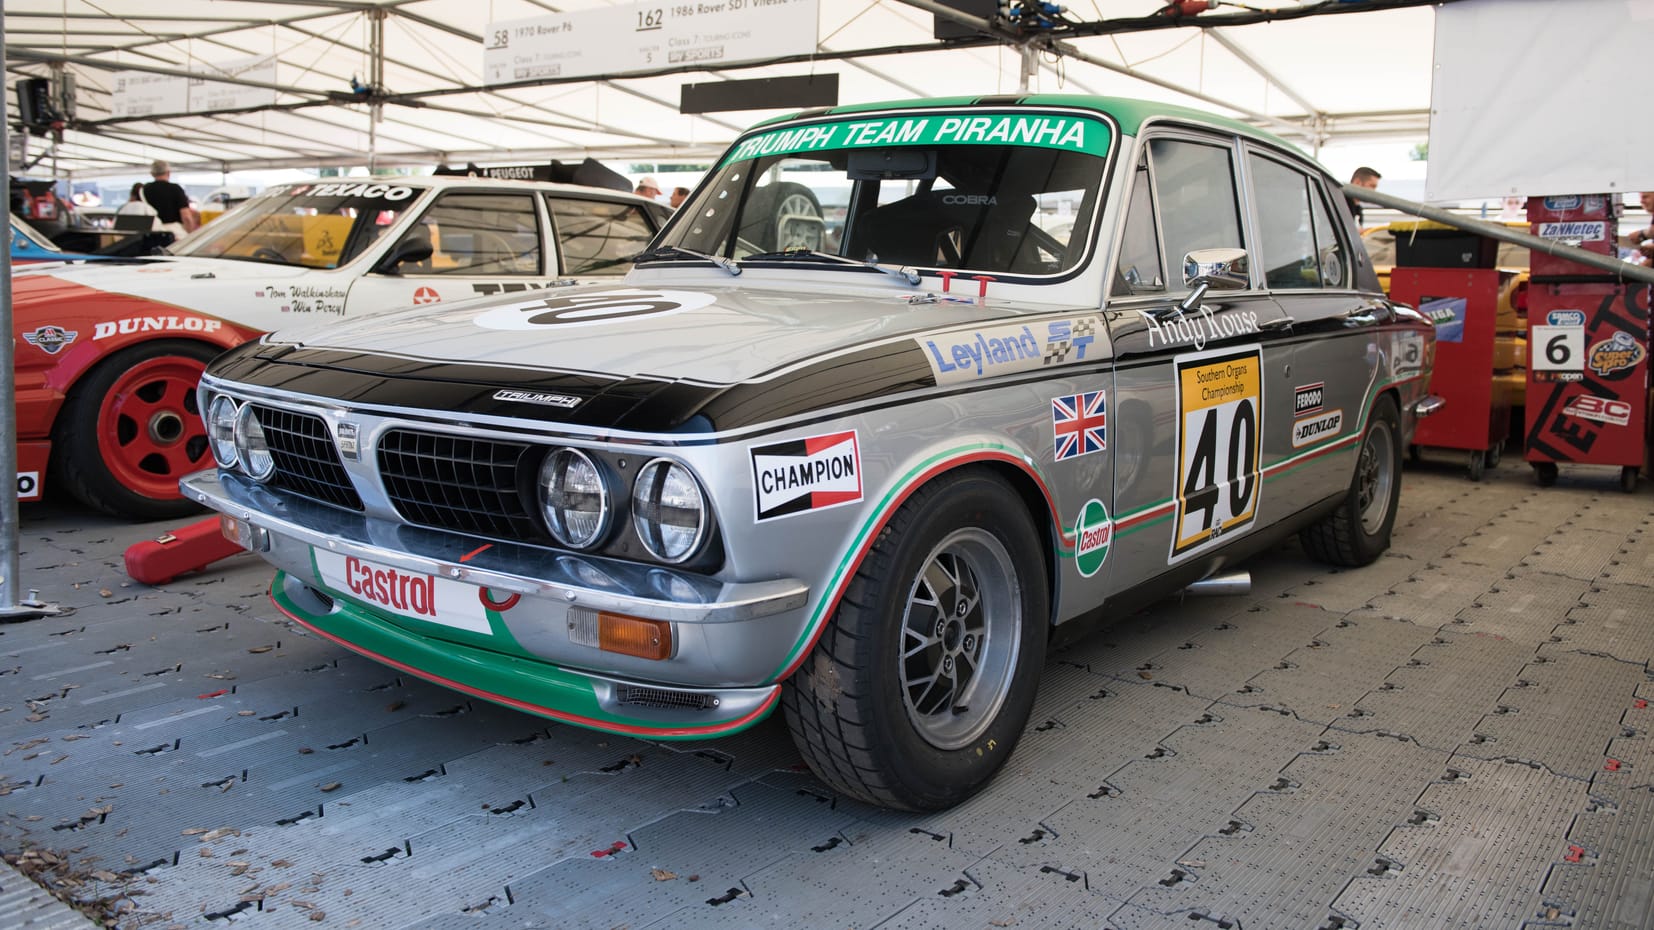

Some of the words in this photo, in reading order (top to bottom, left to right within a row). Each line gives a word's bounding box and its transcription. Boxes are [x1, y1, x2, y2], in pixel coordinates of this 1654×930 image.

[638, 9, 663, 26] 162
[671, 7, 694, 17] 1986
[698, 3, 725, 14] Rover
[494, 30, 508, 46] 58
[537, 25, 560, 35] Rover
[730, 125, 838, 161] TRIUMPH
[842, 119, 930, 146] TEAM
[933, 118, 1085, 148] PIRANHA
[490, 167, 534, 179] PEUGEOT
[306, 184, 413, 201] TEXACO
[942, 195, 998, 206] COBRA
[266, 286, 286, 298] Tom
[290, 286, 345, 298] Walkinshaw
[292, 300, 311, 312] Win
[315, 300, 341, 316] Percy
[93, 316, 221, 340] DUNLOP
[1136, 306, 1205, 351] Andy
[1200, 304, 1262, 339] Rouse
[926, 326, 1041, 376] Leyland
[1545, 334, 1571, 365] 6
[1197, 368, 1225, 383] Southern
[1227, 365, 1247, 379] Organs
[501, 391, 576, 405] TRIUMPH
[1202, 381, 1244, 400] Championship
[1297, 390, 1322, 408] FERODO
[1300, 415, 1340, 439] DUNLOP
[1184, 398, 1256, 531] 40
[762, 454, 854, 494] CHAMPION
[1081, 524, 1110, 551] Castrol
[346, 556, 436, 616] Castrol
